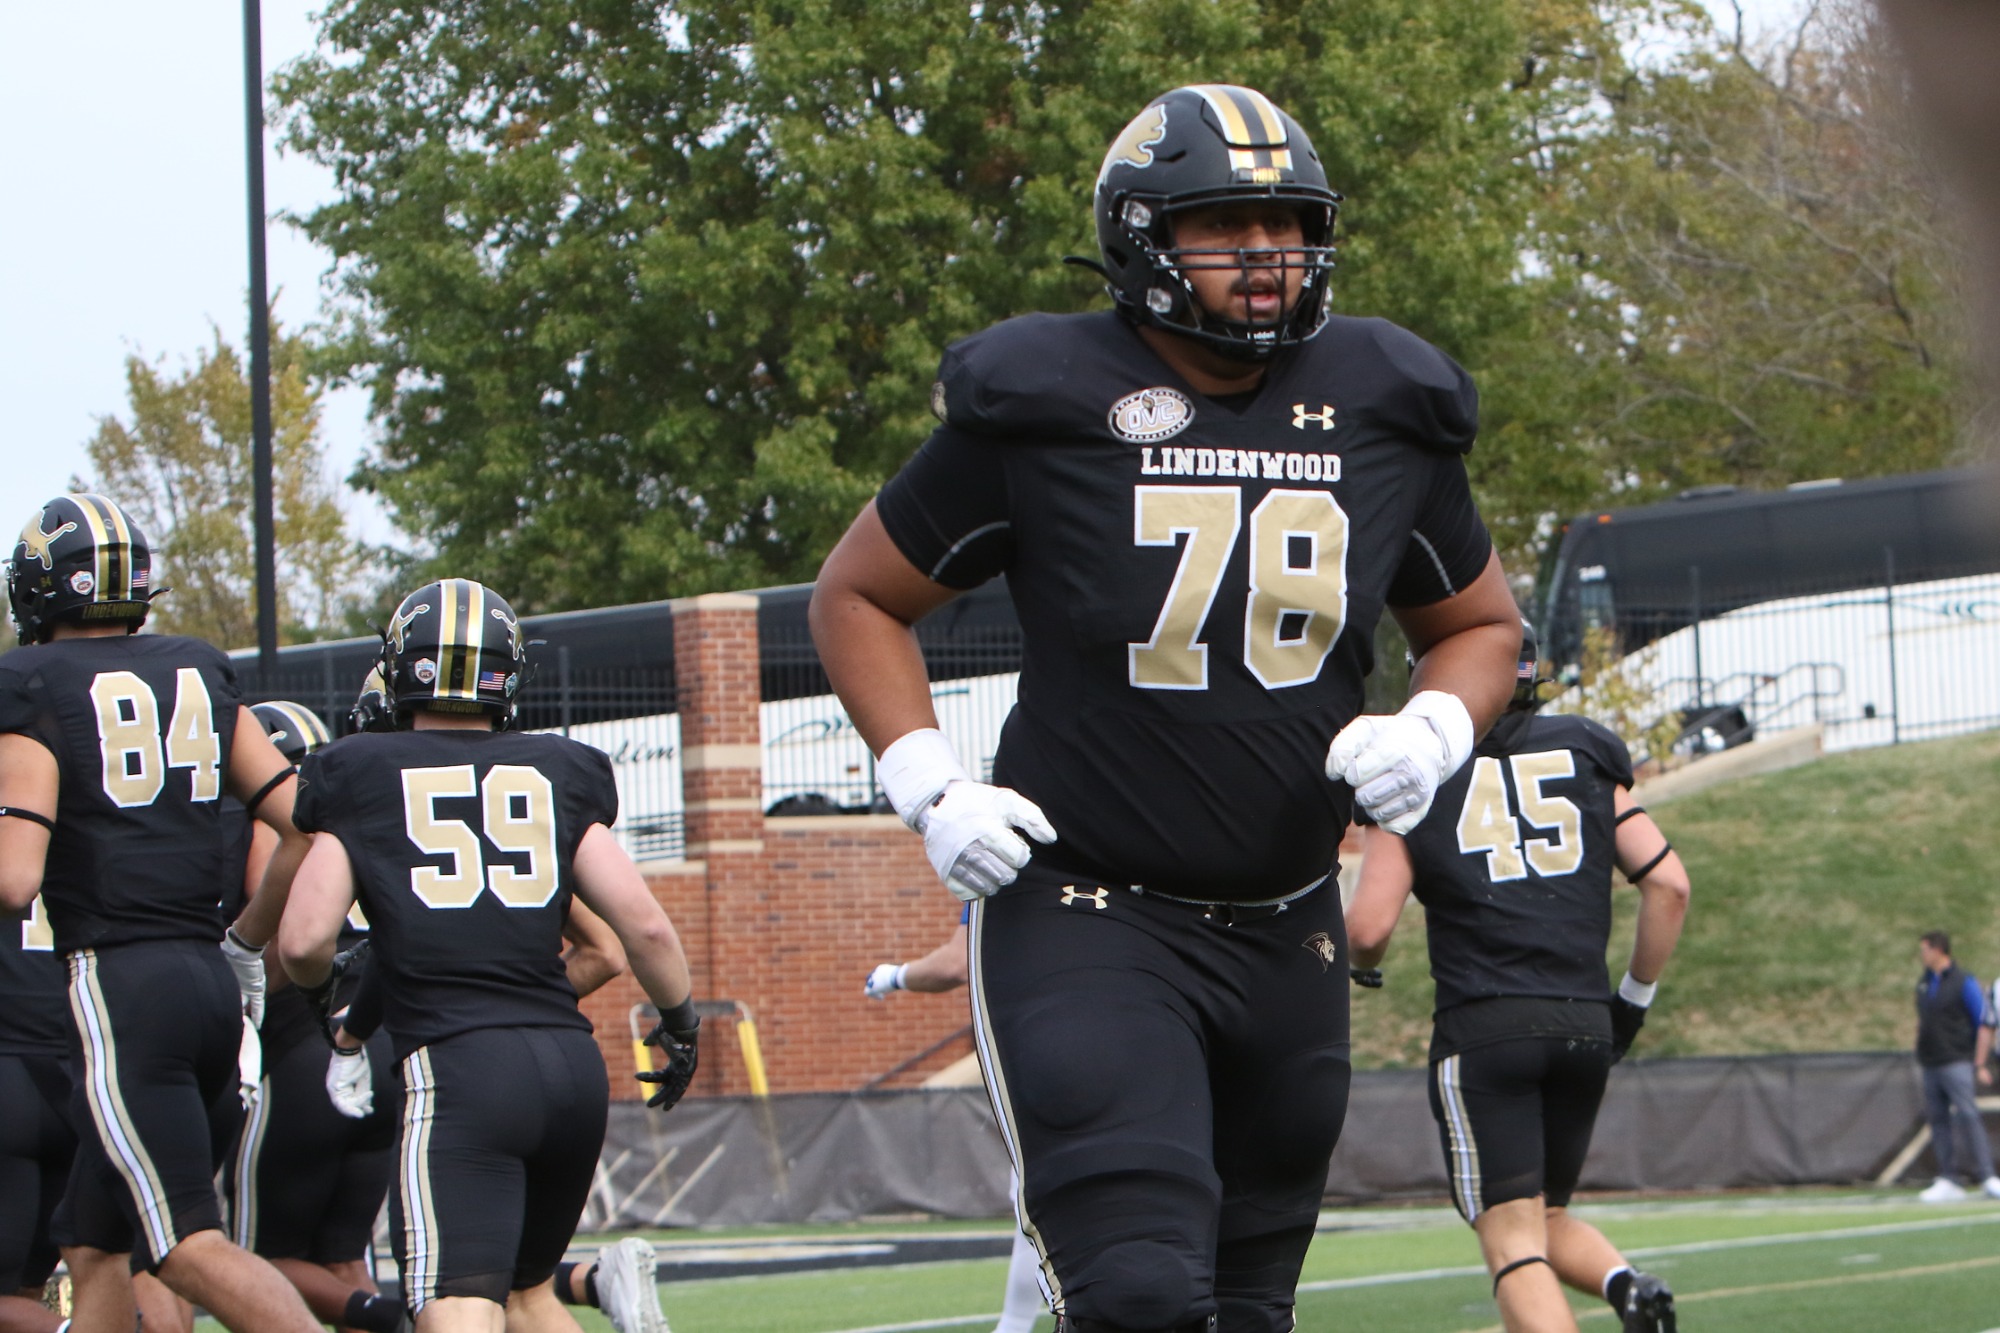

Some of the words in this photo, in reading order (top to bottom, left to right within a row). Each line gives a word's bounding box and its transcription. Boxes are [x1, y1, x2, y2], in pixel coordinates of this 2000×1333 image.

[1126, 400, 1176, 430] OVC
[1140, 446, 1343, 482] LINDENWOOD
[1128, 485, 1350, 691] 78
[90, 667, 221, 809] 84
[401, 764, 559, 909] 59
[1456, 748, 1585, 884] 45
